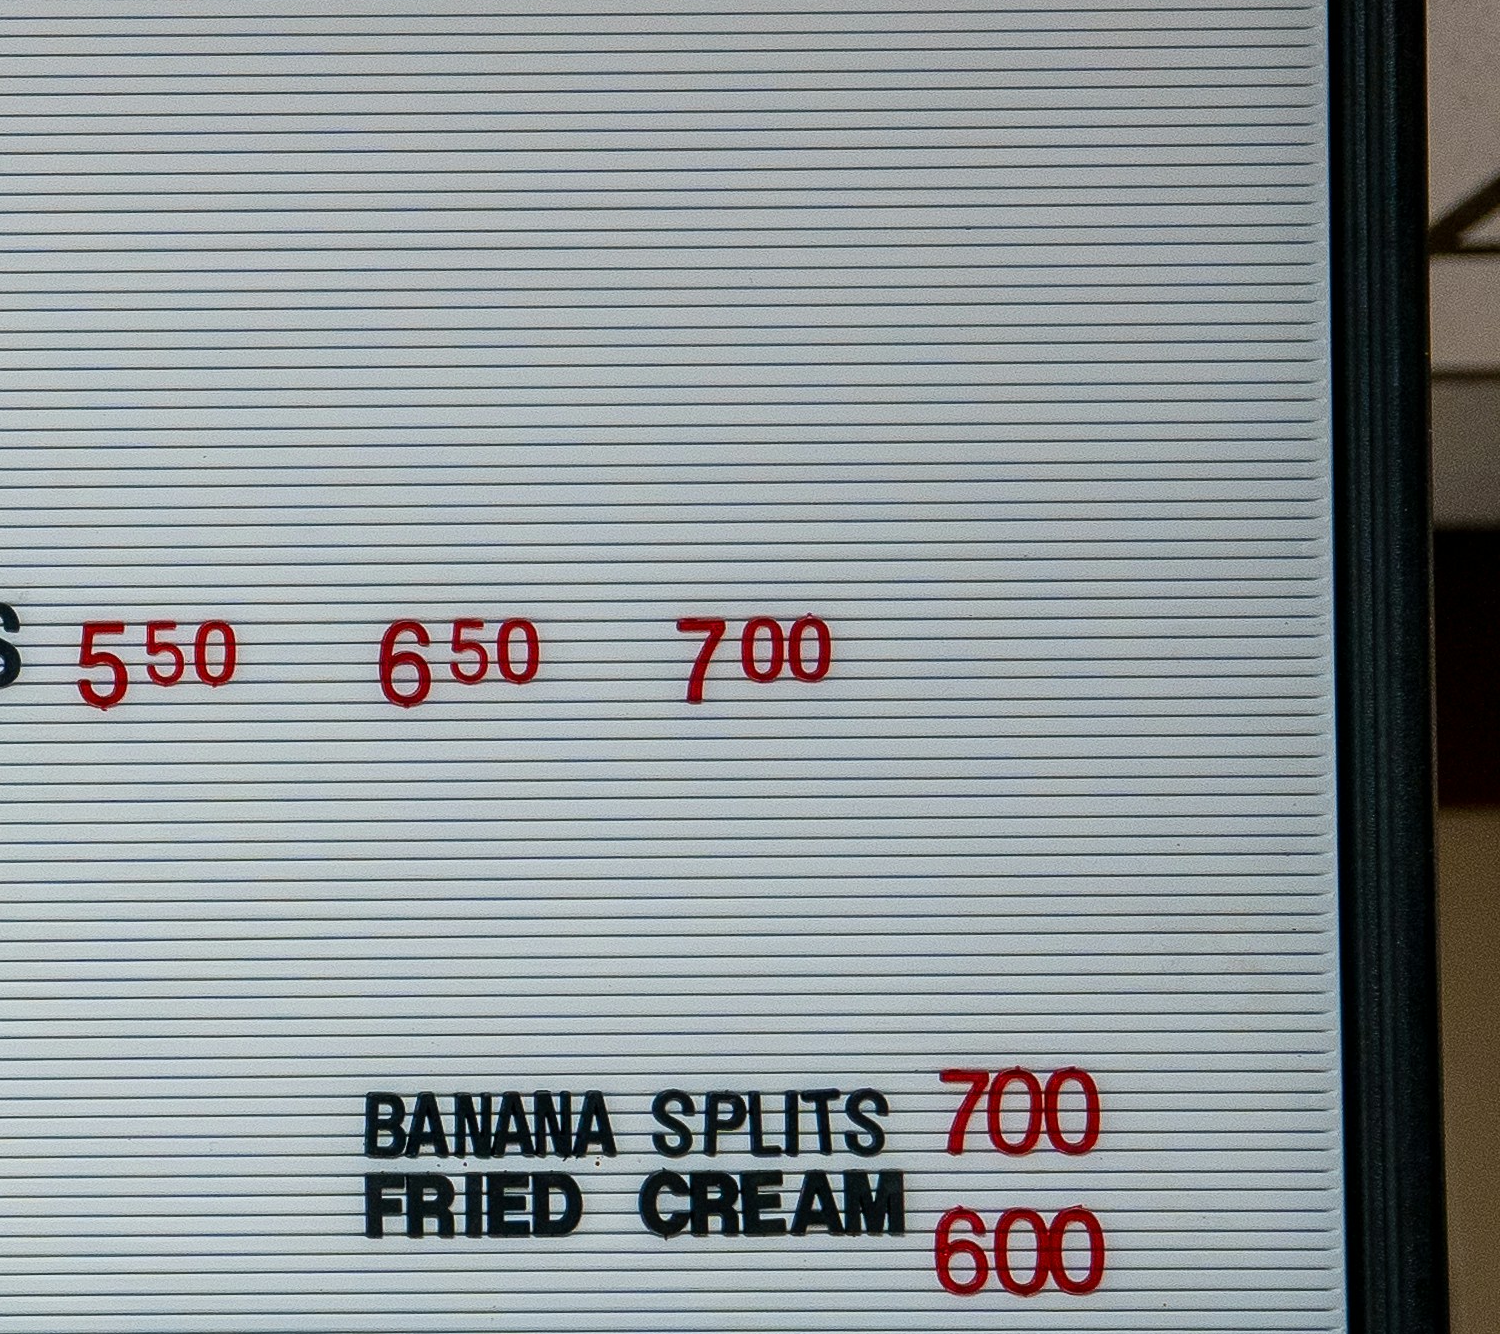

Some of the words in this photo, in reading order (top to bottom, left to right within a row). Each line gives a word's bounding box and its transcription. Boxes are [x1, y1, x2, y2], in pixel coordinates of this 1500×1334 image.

[364, 1089, 616, 1157] BANANA
[651, 1088, 889, 1157] SPLITS
[938, 1066, 1101, 1157] 700
[364, 1171, 583, 1239] FRIED
[638, 1168, 905, 1239] CREAM
[935, 1205, 1105, 1297] 600
